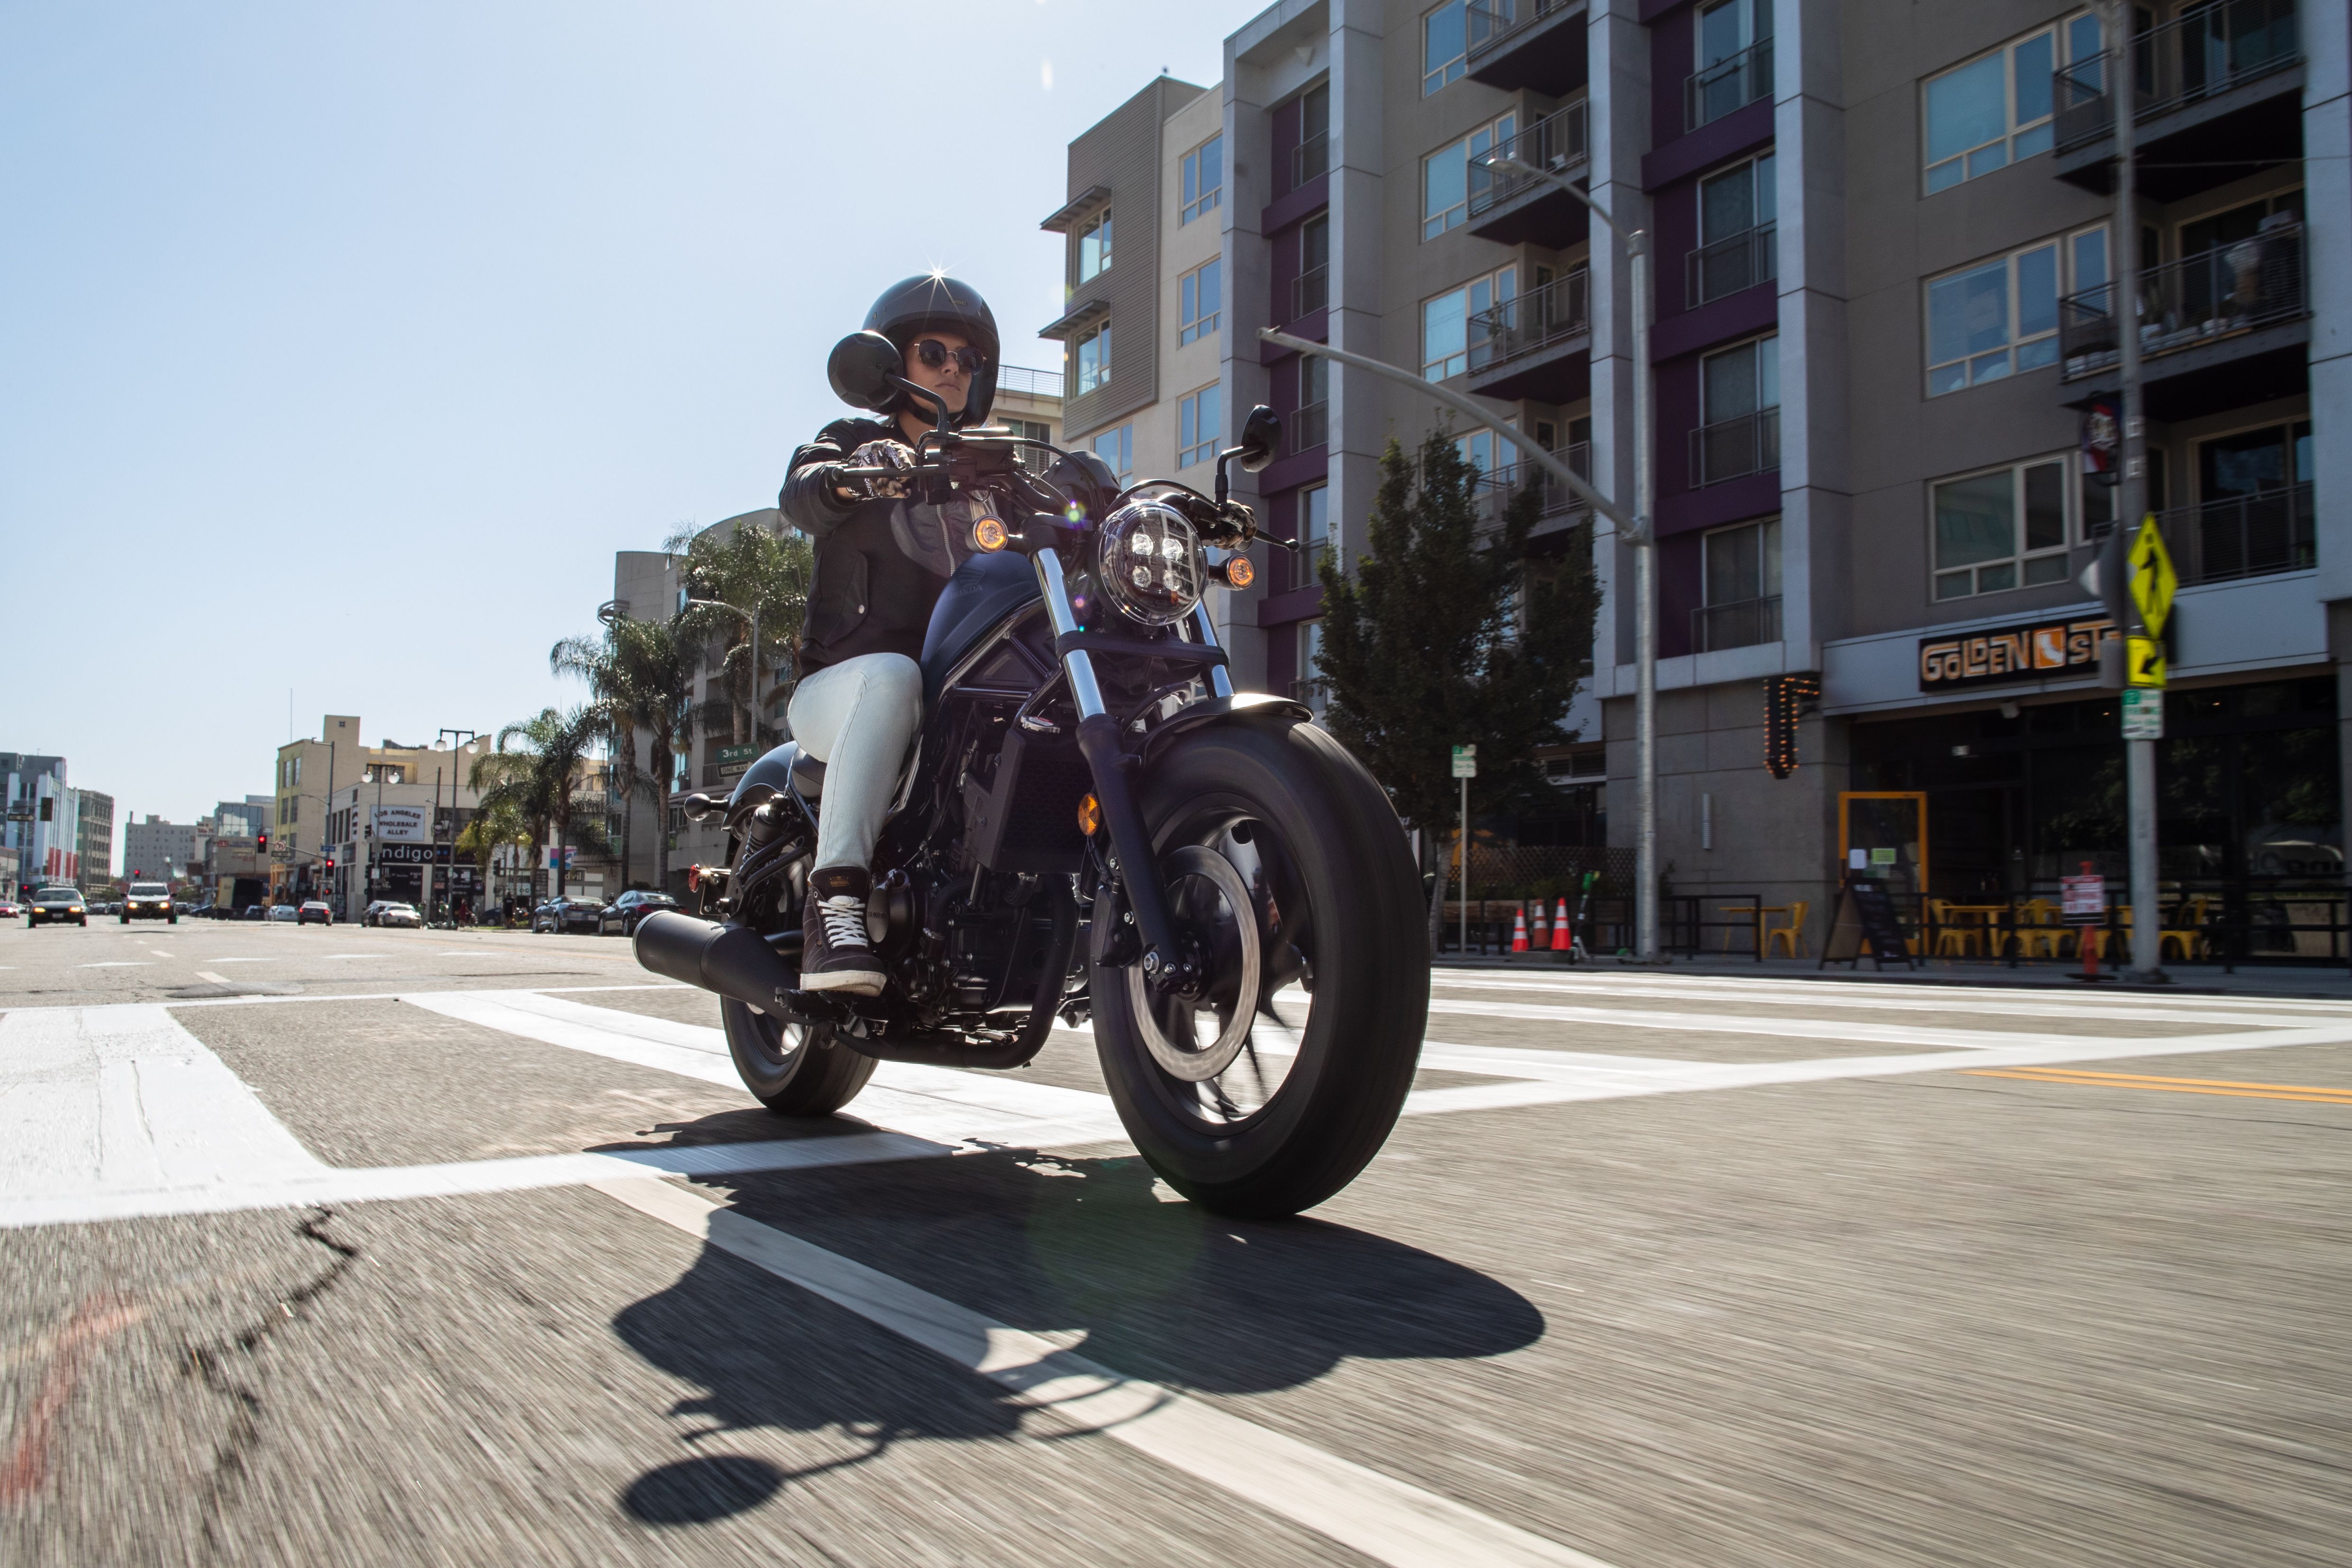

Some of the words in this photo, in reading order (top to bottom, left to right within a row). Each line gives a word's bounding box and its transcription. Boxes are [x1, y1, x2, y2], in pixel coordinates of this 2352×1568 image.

[1921, 631, 2031, 681] GOLDEN
[2068, 618, 2122, 664] ST
[722, 749, 738, 757] 3rd
[391, 810, 421, 819] ANGELES
[382, 846, 433, 862] ndigo
